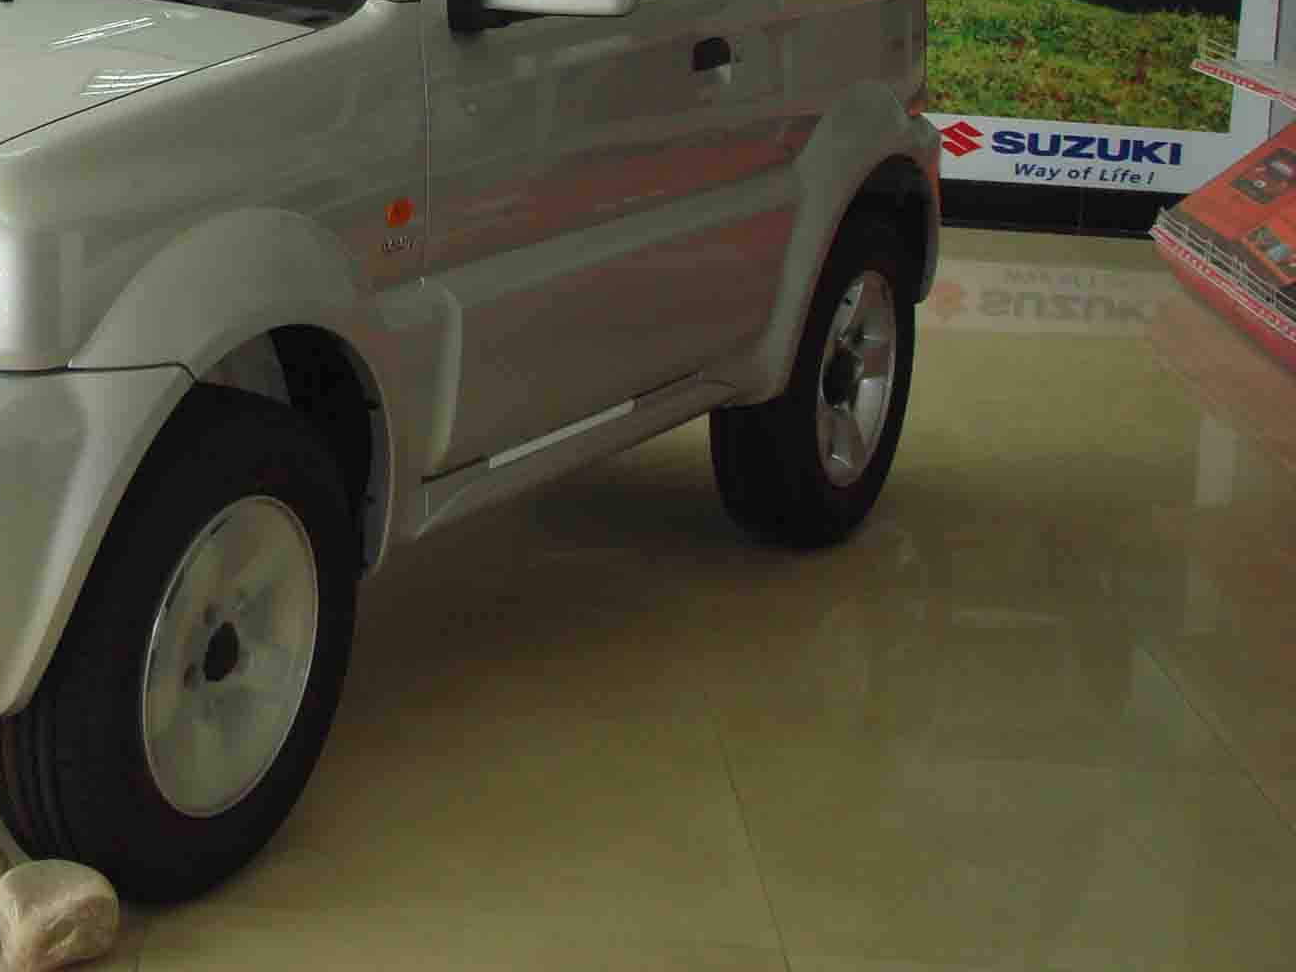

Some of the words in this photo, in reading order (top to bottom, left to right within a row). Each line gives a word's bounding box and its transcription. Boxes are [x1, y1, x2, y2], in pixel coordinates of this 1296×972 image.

[991, 130, 1183, 165] SUZUKI
[1015, 163, 1061, 181] Way
[1068, 163, 1093, 180] of
